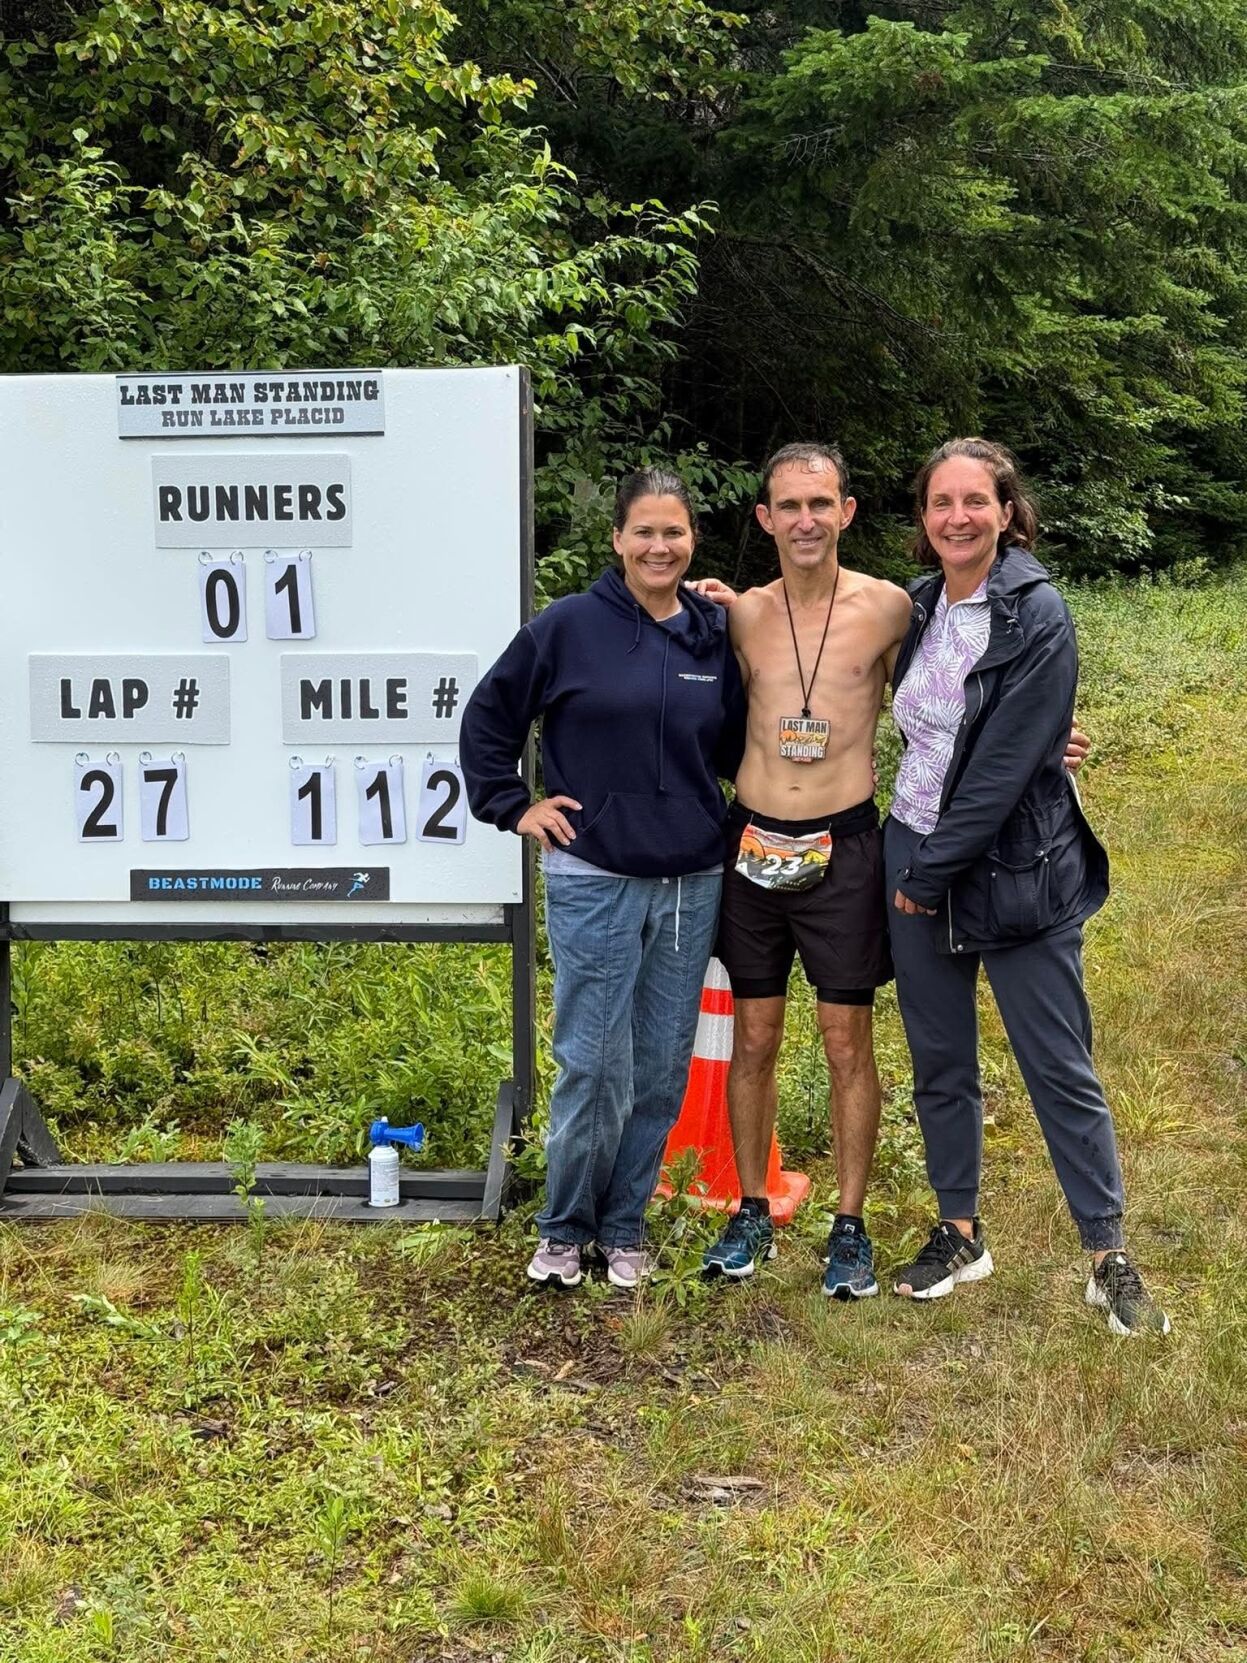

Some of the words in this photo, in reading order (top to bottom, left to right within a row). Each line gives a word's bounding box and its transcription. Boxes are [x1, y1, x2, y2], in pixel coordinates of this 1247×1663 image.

[120, 384, 182, 405] LAST
[191, 383, 246, 404] MAN
[253, 380, 380, 403] STANDING
[161, 409, 204, 427] RUN
[210, 408, 264, 426] LAKE
[270, 407, 345, 425] PLACID
[158, 483, 347, 522] RUNNERS
[59, 678, 150, 720] LAP
[172, 678, 200, 720] #
[299, 678, 409, 720] MILE
[432, 677, 460, 719] #
[782, 719, 804, 732] LAST
[805, 721, 827, 734] MAN
[780, 744, 824, 759] STANDING
[761, 853, 803, 875] 23
[148, 877, 263, 890] BEASTMODE
